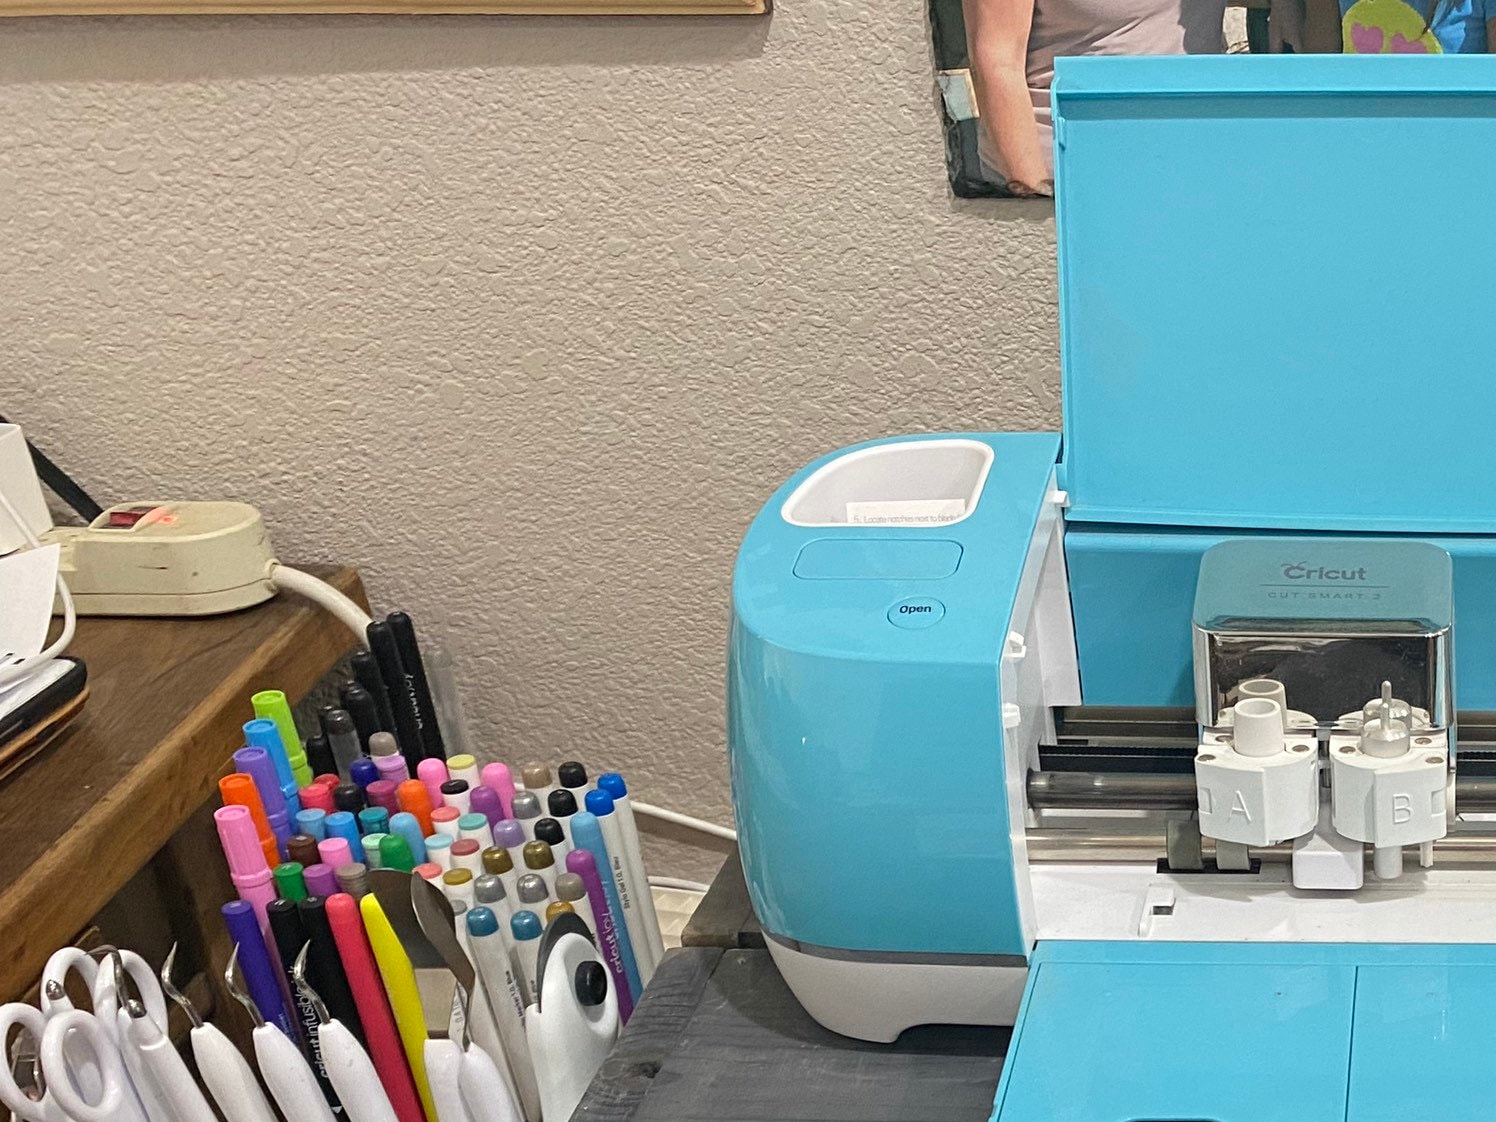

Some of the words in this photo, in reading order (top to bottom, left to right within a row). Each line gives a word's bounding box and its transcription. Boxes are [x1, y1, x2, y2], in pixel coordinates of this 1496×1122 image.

[1281, 560, 1367, 582] Cricut
[1308, 592, 1366, 600] SMART
[899, 604, 932, 615] Open
[1229, 790, 1252, 823] A
[1392, 793, 1412, 824] B
